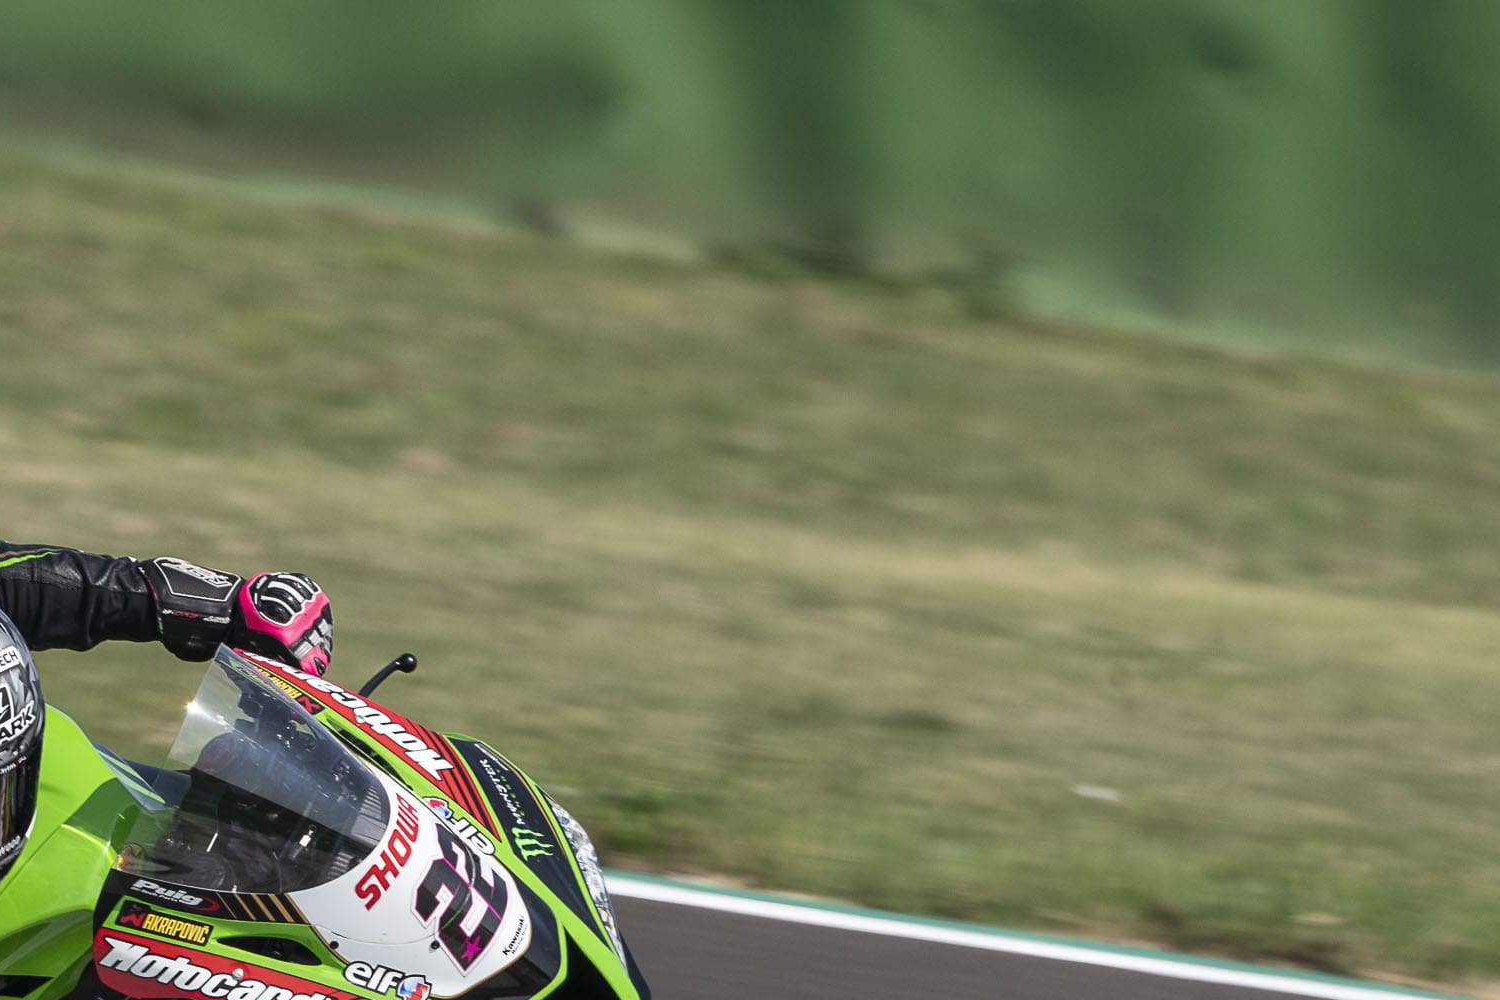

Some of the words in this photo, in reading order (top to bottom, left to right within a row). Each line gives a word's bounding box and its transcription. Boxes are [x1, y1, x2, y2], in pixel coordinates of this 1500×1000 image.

[448, 811, 496, 855] elf
[355, 792, 419, 910] SHOWA
[131, 879, 203, 906] Puig
[142, 912, 211, 943] AKRAPOVIČ
[345, 962, 402, 992] elf
